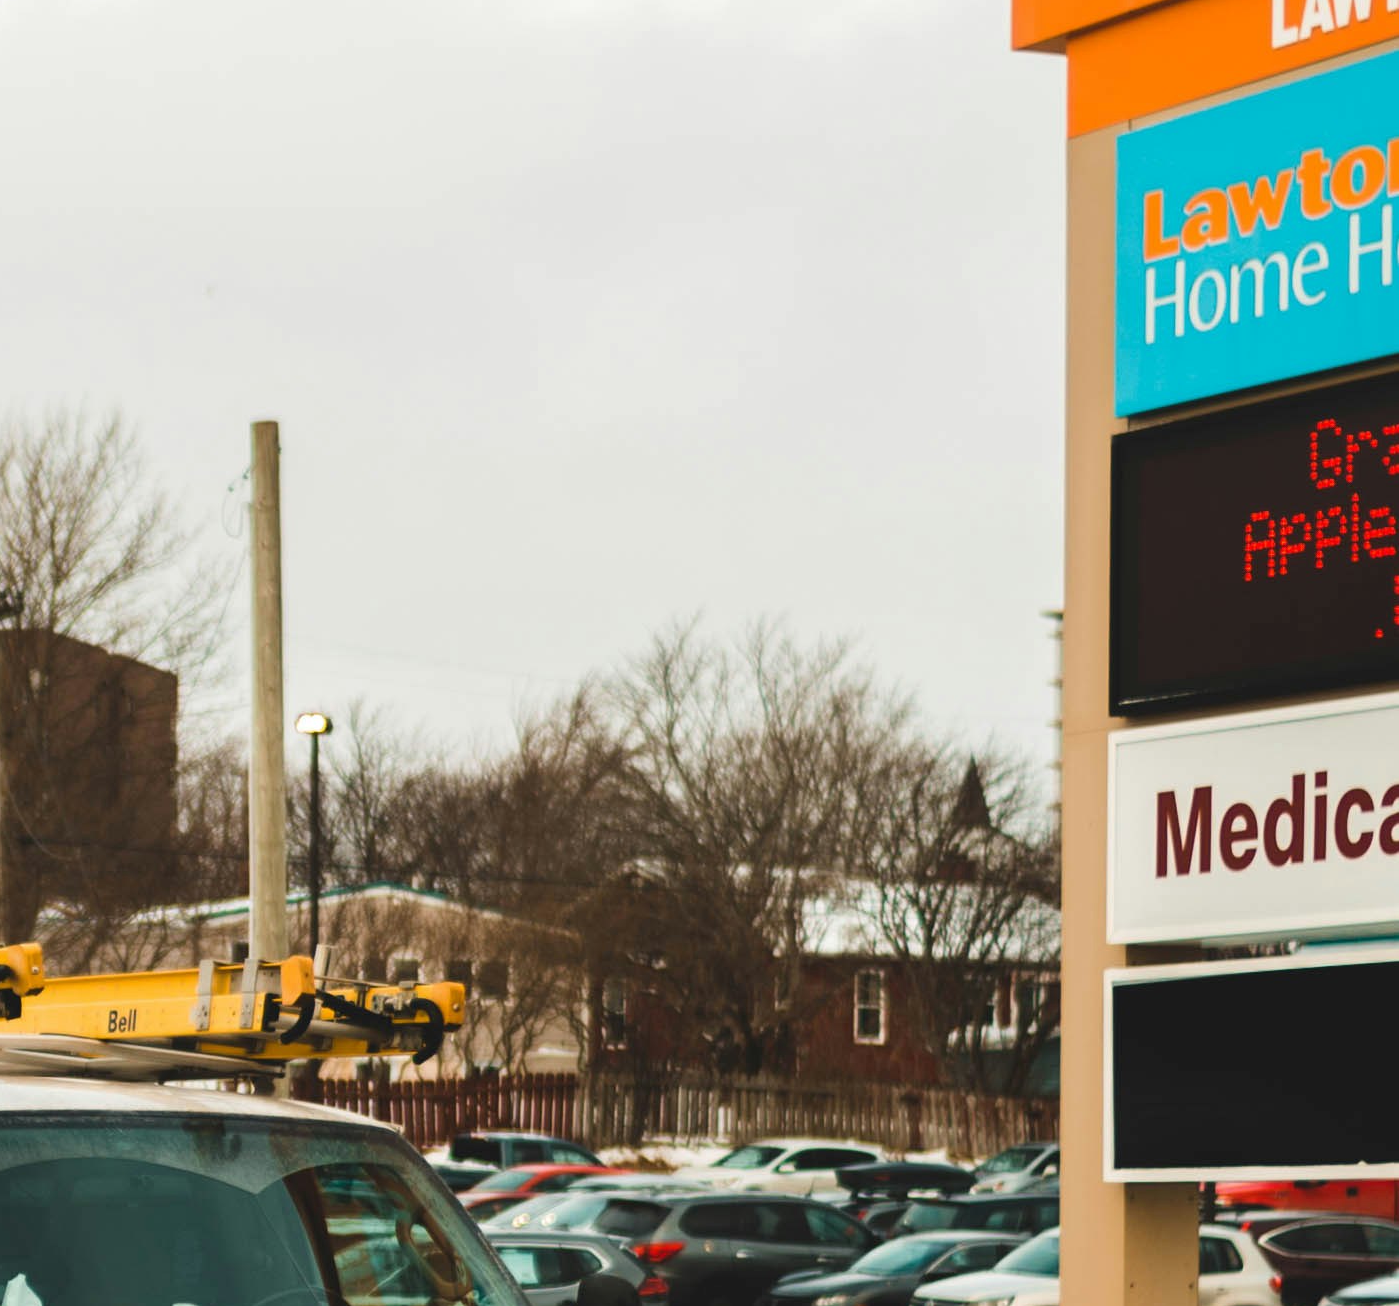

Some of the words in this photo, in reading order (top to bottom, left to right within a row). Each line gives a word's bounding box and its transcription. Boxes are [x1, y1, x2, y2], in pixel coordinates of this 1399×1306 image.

[1145, 242, 1330, 345] Home
[1348, 203, 1399, 294] H
[1244, 493, 1396, 582] Apple
[107, 1008, 137, 1033] Bell
